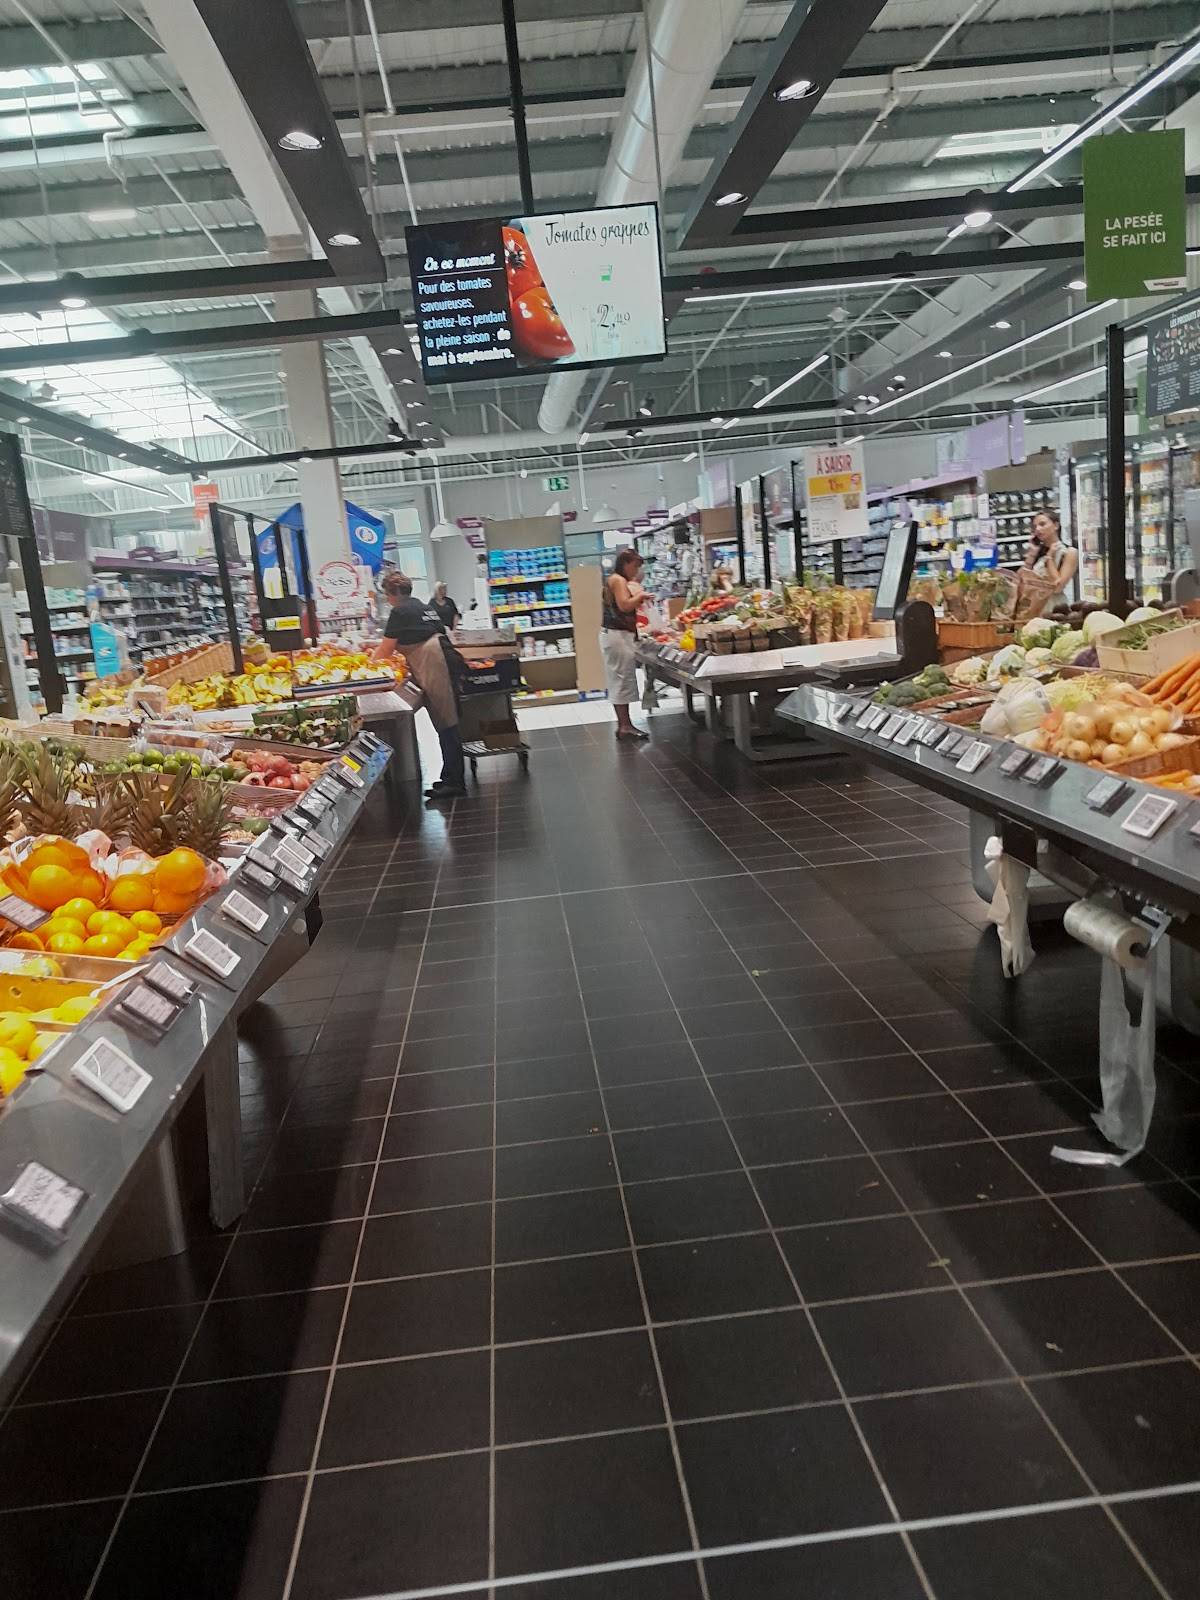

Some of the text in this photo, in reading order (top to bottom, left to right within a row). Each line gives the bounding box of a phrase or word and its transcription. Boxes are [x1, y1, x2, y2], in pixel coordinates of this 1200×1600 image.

[1105, 211, 1163, 230] LA PESÉE
[545, 221, 650, 247] Tomates grappes
[1103, 231, 1166, 248] SE FAIT ICI
[455, 253, 496, 268] moment
[418, 277, 492, 295] Pour des tomates
[422, 310, 507, 330] achetez-les pendant
[424, 335, 434, 348] la
[435, 333, 462, 350] pleine
[462, 331, 490, 345] saison
[427, 352, 448, 367] mai
[448, 351, 456, 365] à
